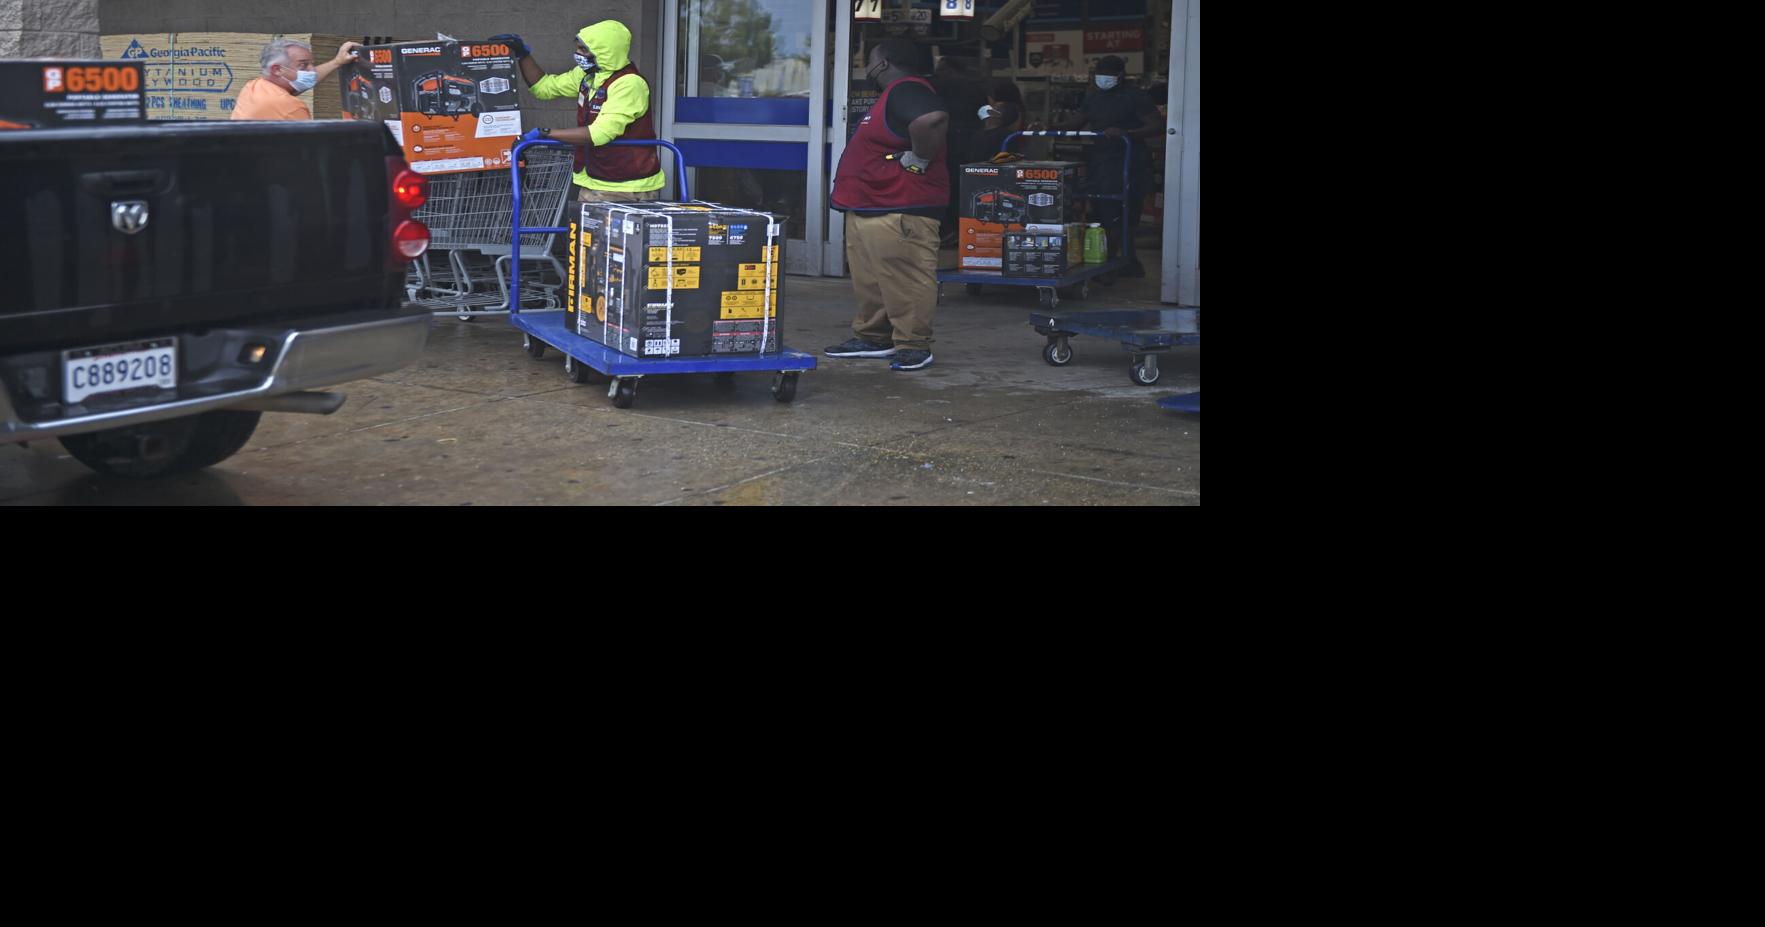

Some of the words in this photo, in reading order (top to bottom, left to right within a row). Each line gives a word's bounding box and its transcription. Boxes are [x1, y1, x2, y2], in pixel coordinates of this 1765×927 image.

[1086, 30, 1141, 41] STARTING
[401, 46, 441, 54] GENERAC
[1105, 40, 1120, 49] AT
[471, 44, 510, 57] 6500
[144, 68, 222, 76] YTANIUM
[65, 66, 139, 92] 6500
[1025, 169, 1058, 180] 6500
[568, 222, 577, 313] FIRMAN
[73, 354, 172, 389] C889208
